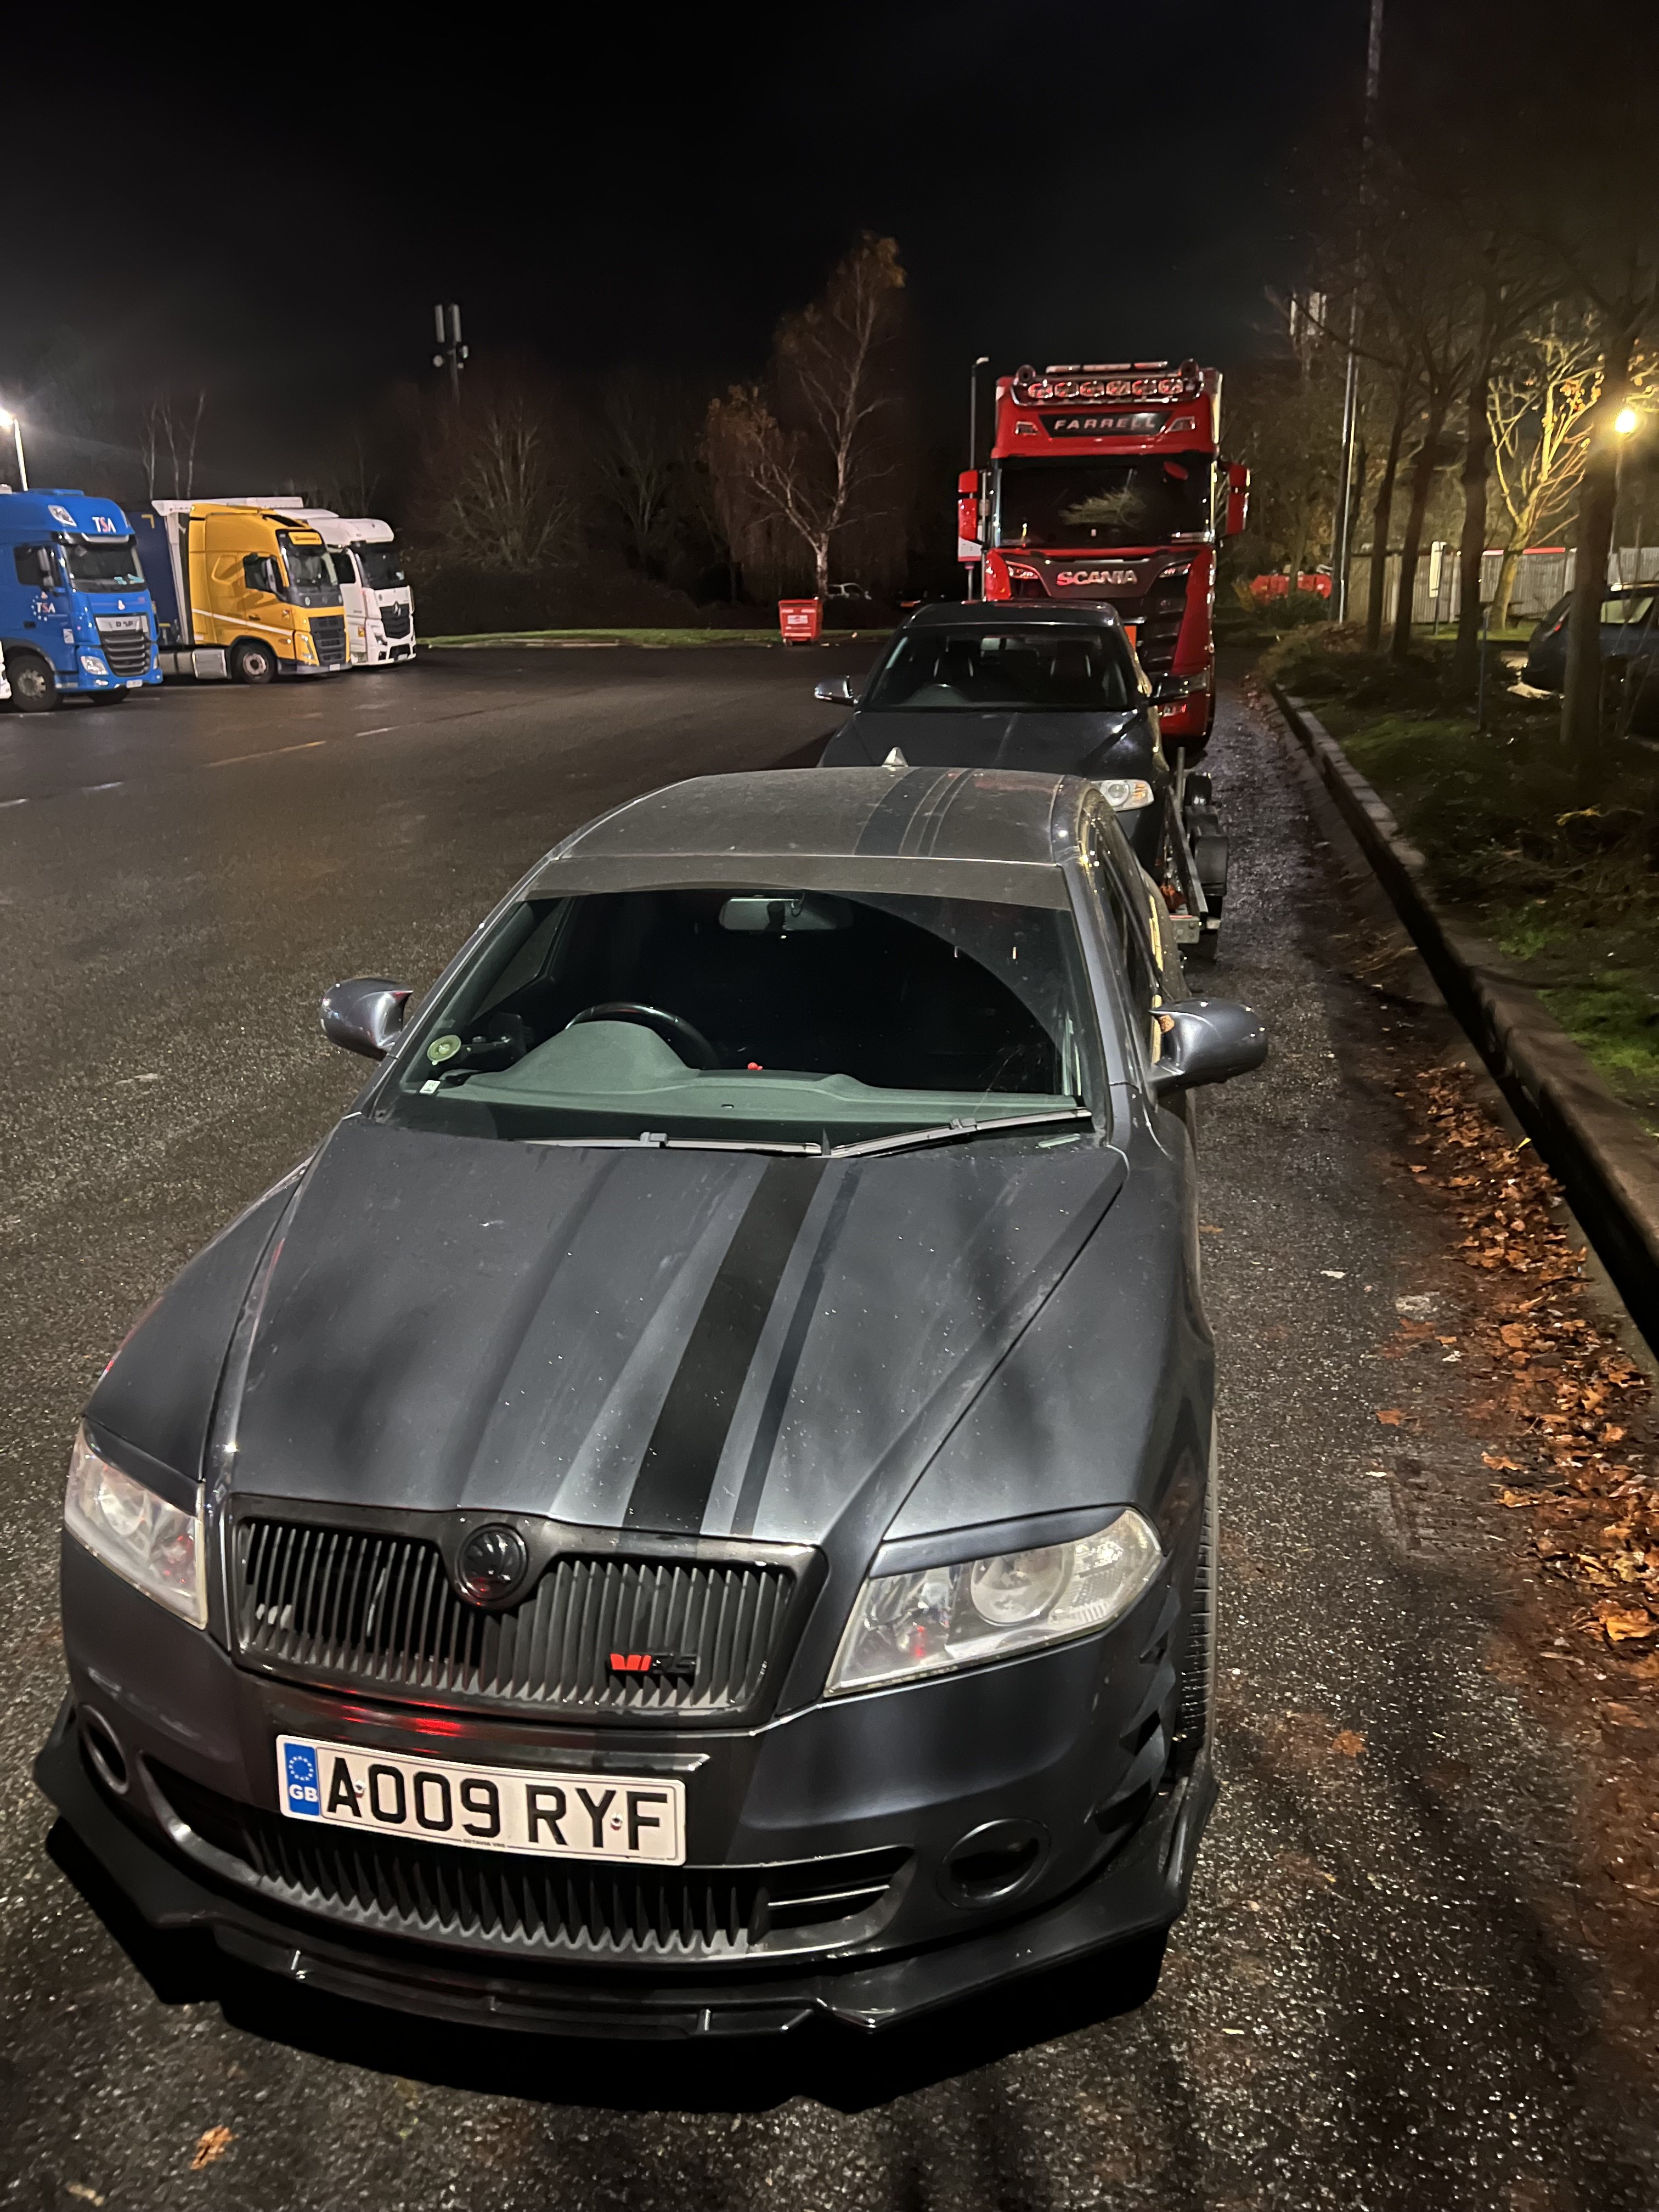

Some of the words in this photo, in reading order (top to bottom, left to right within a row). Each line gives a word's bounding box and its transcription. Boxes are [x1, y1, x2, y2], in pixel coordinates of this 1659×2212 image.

[92, 516, 116, 533] TSA
[1056, 570, 1138, 586] SCANIA
[289, 1784, 318, 1802] GB
[525, 1784, 668, 1850] RYF
